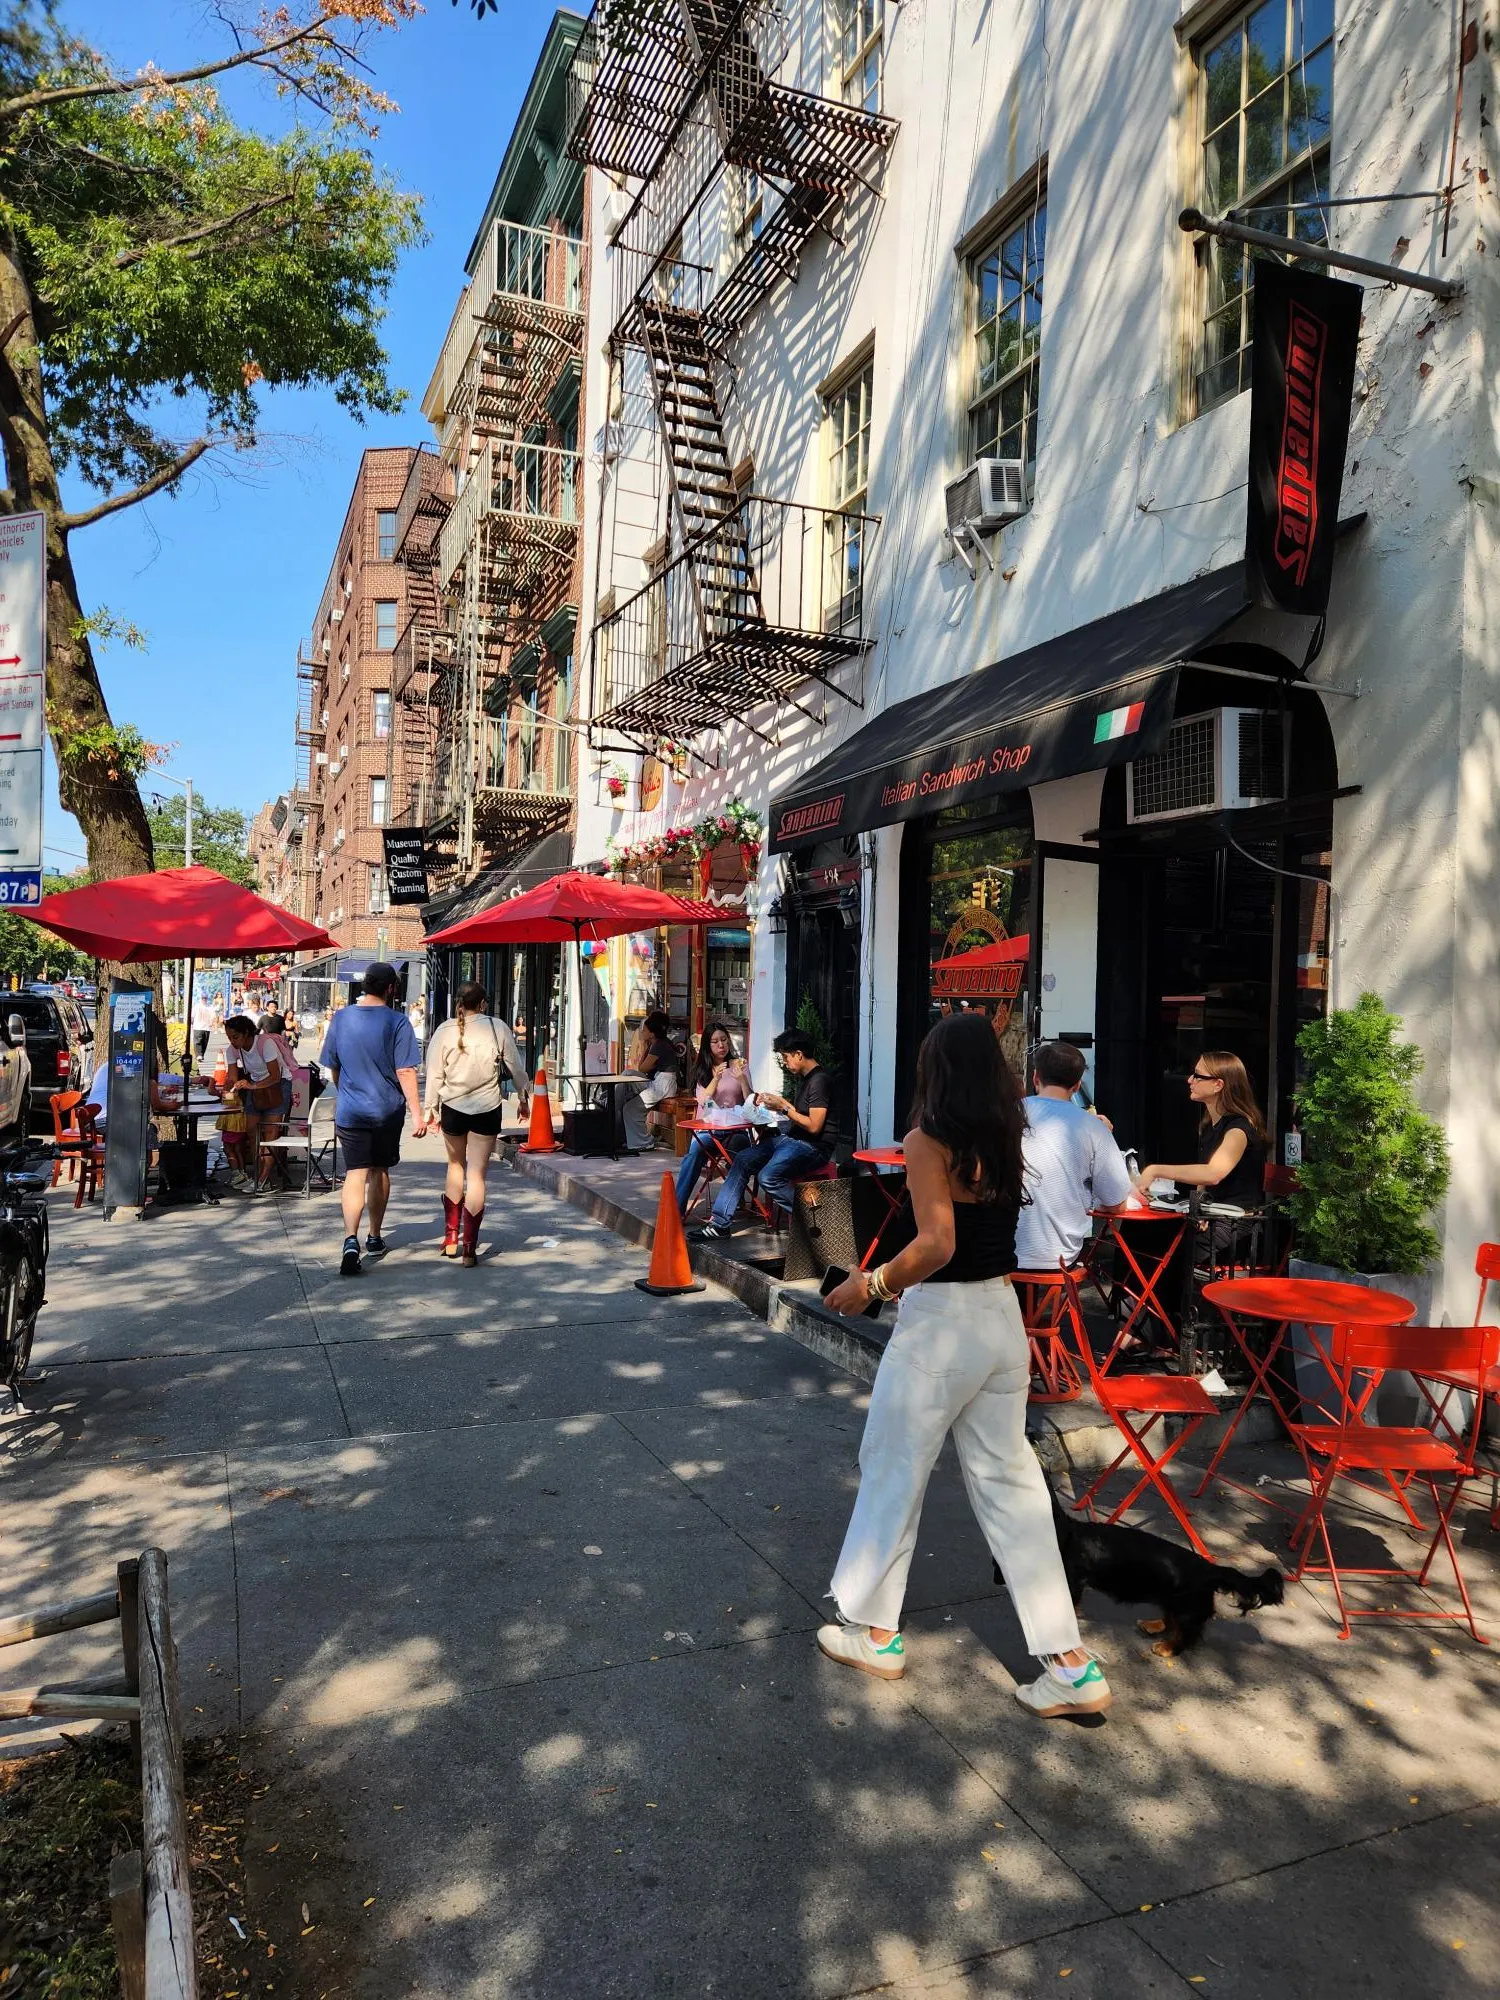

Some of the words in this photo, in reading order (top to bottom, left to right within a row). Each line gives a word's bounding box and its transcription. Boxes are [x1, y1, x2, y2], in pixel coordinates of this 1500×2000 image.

[1275, 310, 1322, 588] Sanpanino
[12, 698, 34, 711] Sunday
[881, 780, 917, 807] Italian
[919, 756, 986, 796] Sandwich
[989, 743, 1031, 774] Shop
[777, 796, 844, 839] Sanpanino
[386, 839, 422, 849] Museum
[390, 853, 420, 866] Quality
[391, 869, 422, 879] Custom
[392, 883, 425, 894] Framing
